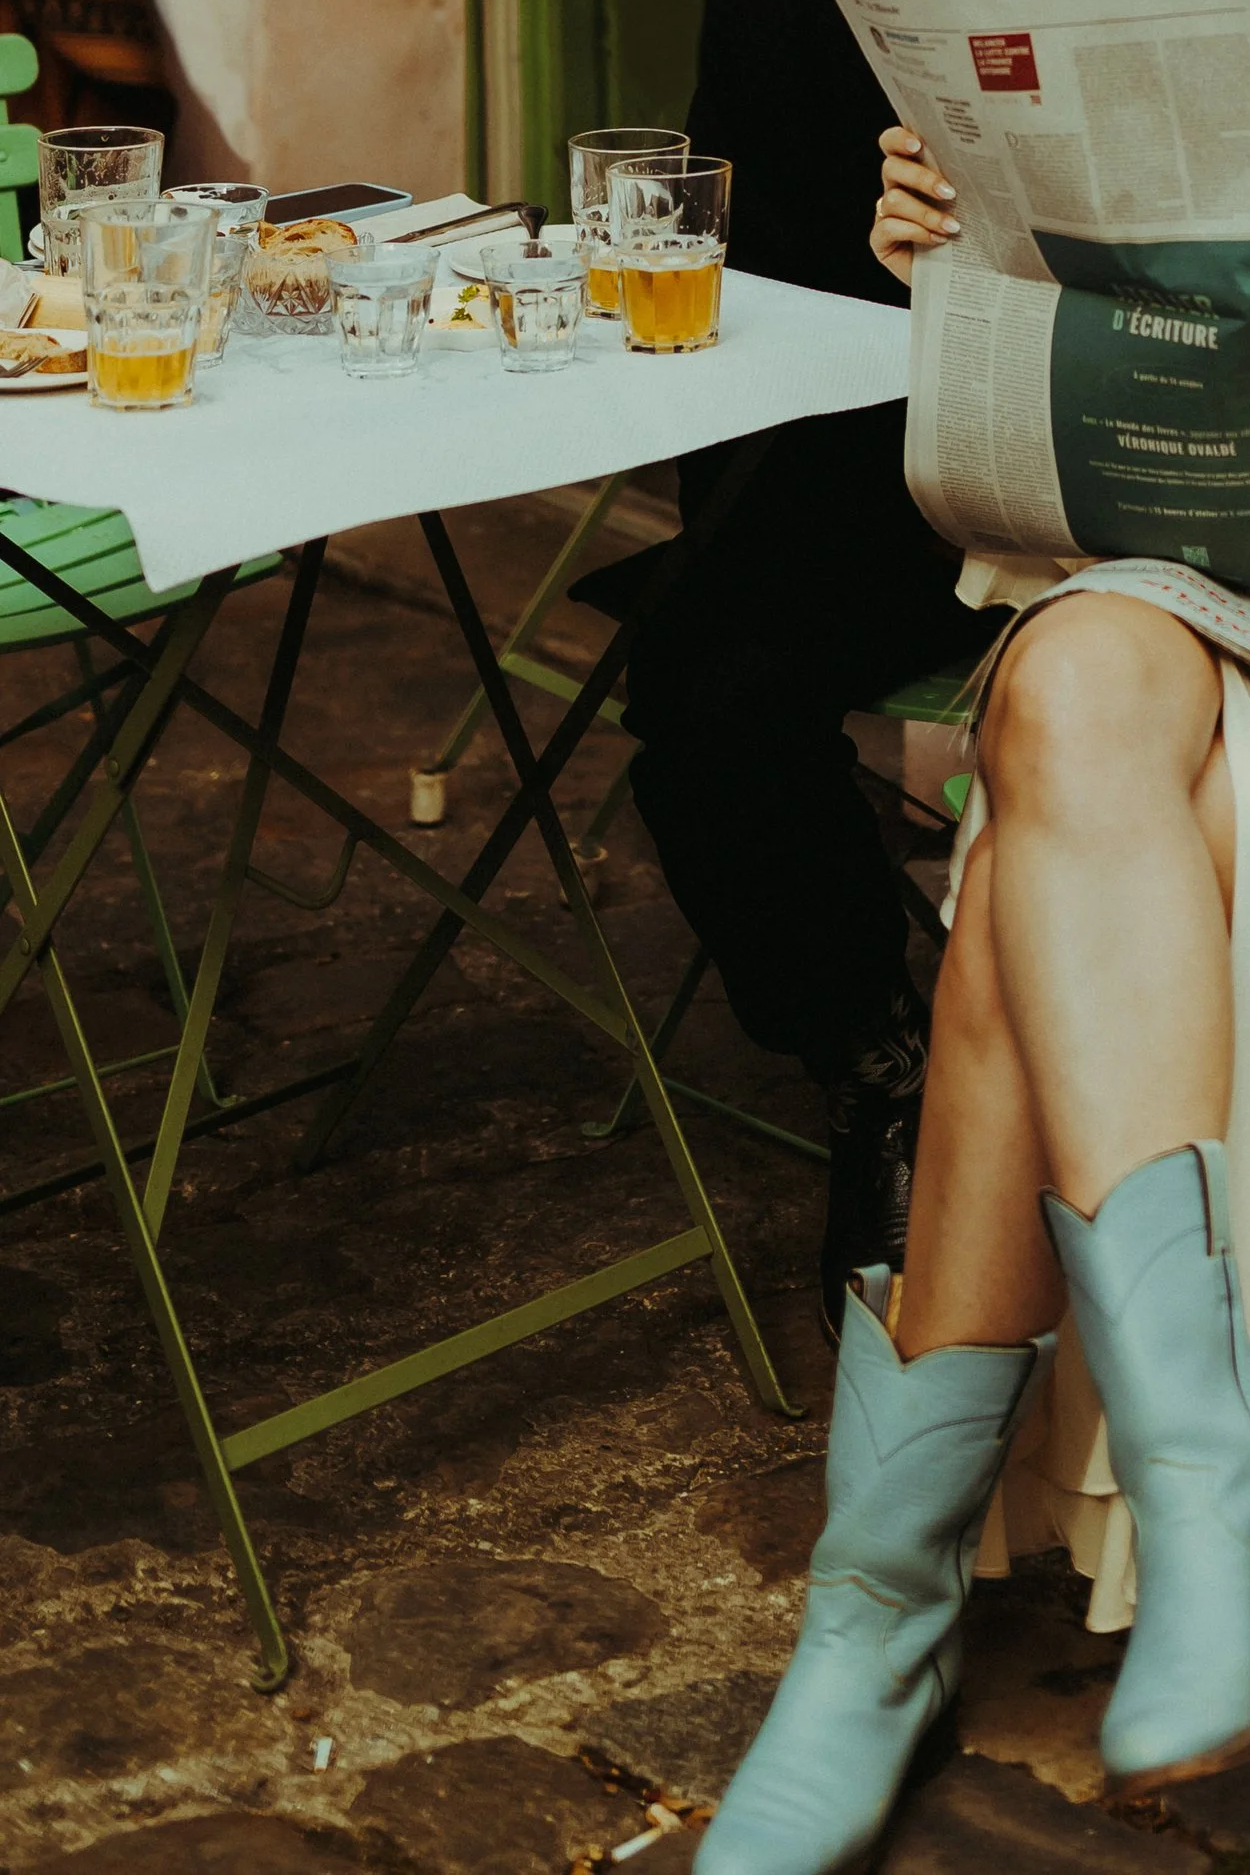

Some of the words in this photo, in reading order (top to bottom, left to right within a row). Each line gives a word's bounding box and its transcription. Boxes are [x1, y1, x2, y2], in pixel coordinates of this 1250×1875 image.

[1112, 306, 1219, 350] D'ÉCRITURE
[1116, 432, 1185, 456] VÉRONIQUE
[1188, 440, 1237, 457] OVALDÉ
